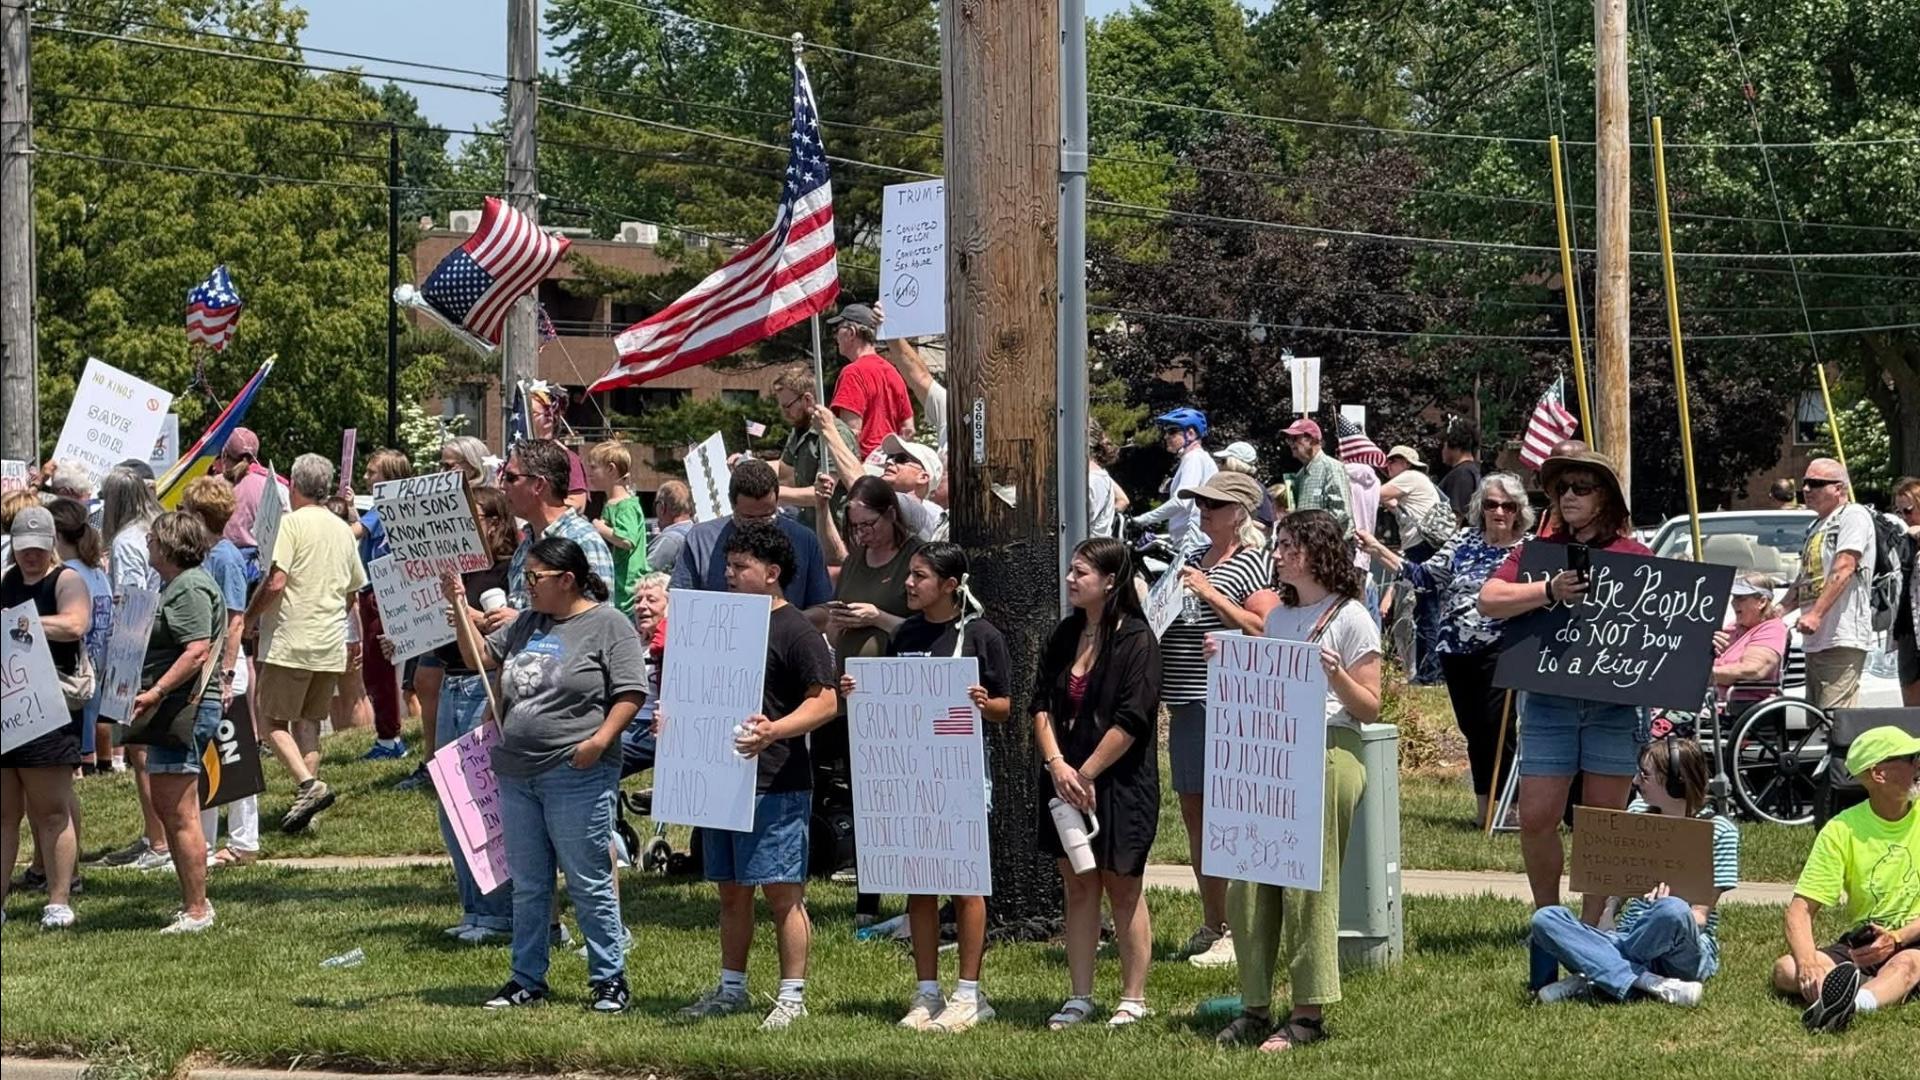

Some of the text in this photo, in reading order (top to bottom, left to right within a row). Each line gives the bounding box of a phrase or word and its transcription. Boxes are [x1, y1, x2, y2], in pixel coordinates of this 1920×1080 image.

[898, 186, 944, 205] TRUMP
[903, 232, 929, 244] FELON
[93, 373, 134, 399] NO KINGS
[88, 405, 132, 433] SAVE
[66, 444, 112, 471] DEMOCRA
[87, 429, 123, 454] OUR
[374, 471, 460, 500] I PROTEST
[377, 494, 459, 521] SO MY SONS
[386, 523, 426, 543] KNOW
[427, 517, 456, 536] THAT
[391, 536, 472, 561] IS NOT HOW A
[405, 560, 436, 580] REAL
[411, 582, 443, 611] SILE
[1618, 564, 1716, 630] People
[673, 598, 743, 652] WE ARE
[1556, 619, 1683, 650] do NOT bow
[1213, 639, 1317, 683] INJUSTICE
[1537, 645, 1668, 688] to a king!
[665, 661, 762, 711] ALL WALKING
[853, 662, 953, 697] I DID NOT
[1214, 672, 1288, 713] ANYWHERE
[661, 716, 685, 758] ON
[855, 702, 922, 740] GROW UP
[1213, 707, 1299, 745] IS A THREAT
[217, 719, 241, 765] NO
[1212, 739, 1295, 780] TO JUSTICE
[858, 744, 918, 776] SAYING
[660, 767, 707, 817] LAND.
[858, 779, 947, 815] LIBERTY AND
[1211, 775, 1296, 821] EVERYWHERE
[862, 816, 910, 848] JUSTICE
[912, 816, 933, 849] FOR
[966, 820, 981, 852] TO
[1585, 811, 1676, 833] THE ONLY
[861, 854, 980, 890] ACCEPT ANYTHING LESS
[1585, 871, 1612, 885] THE
